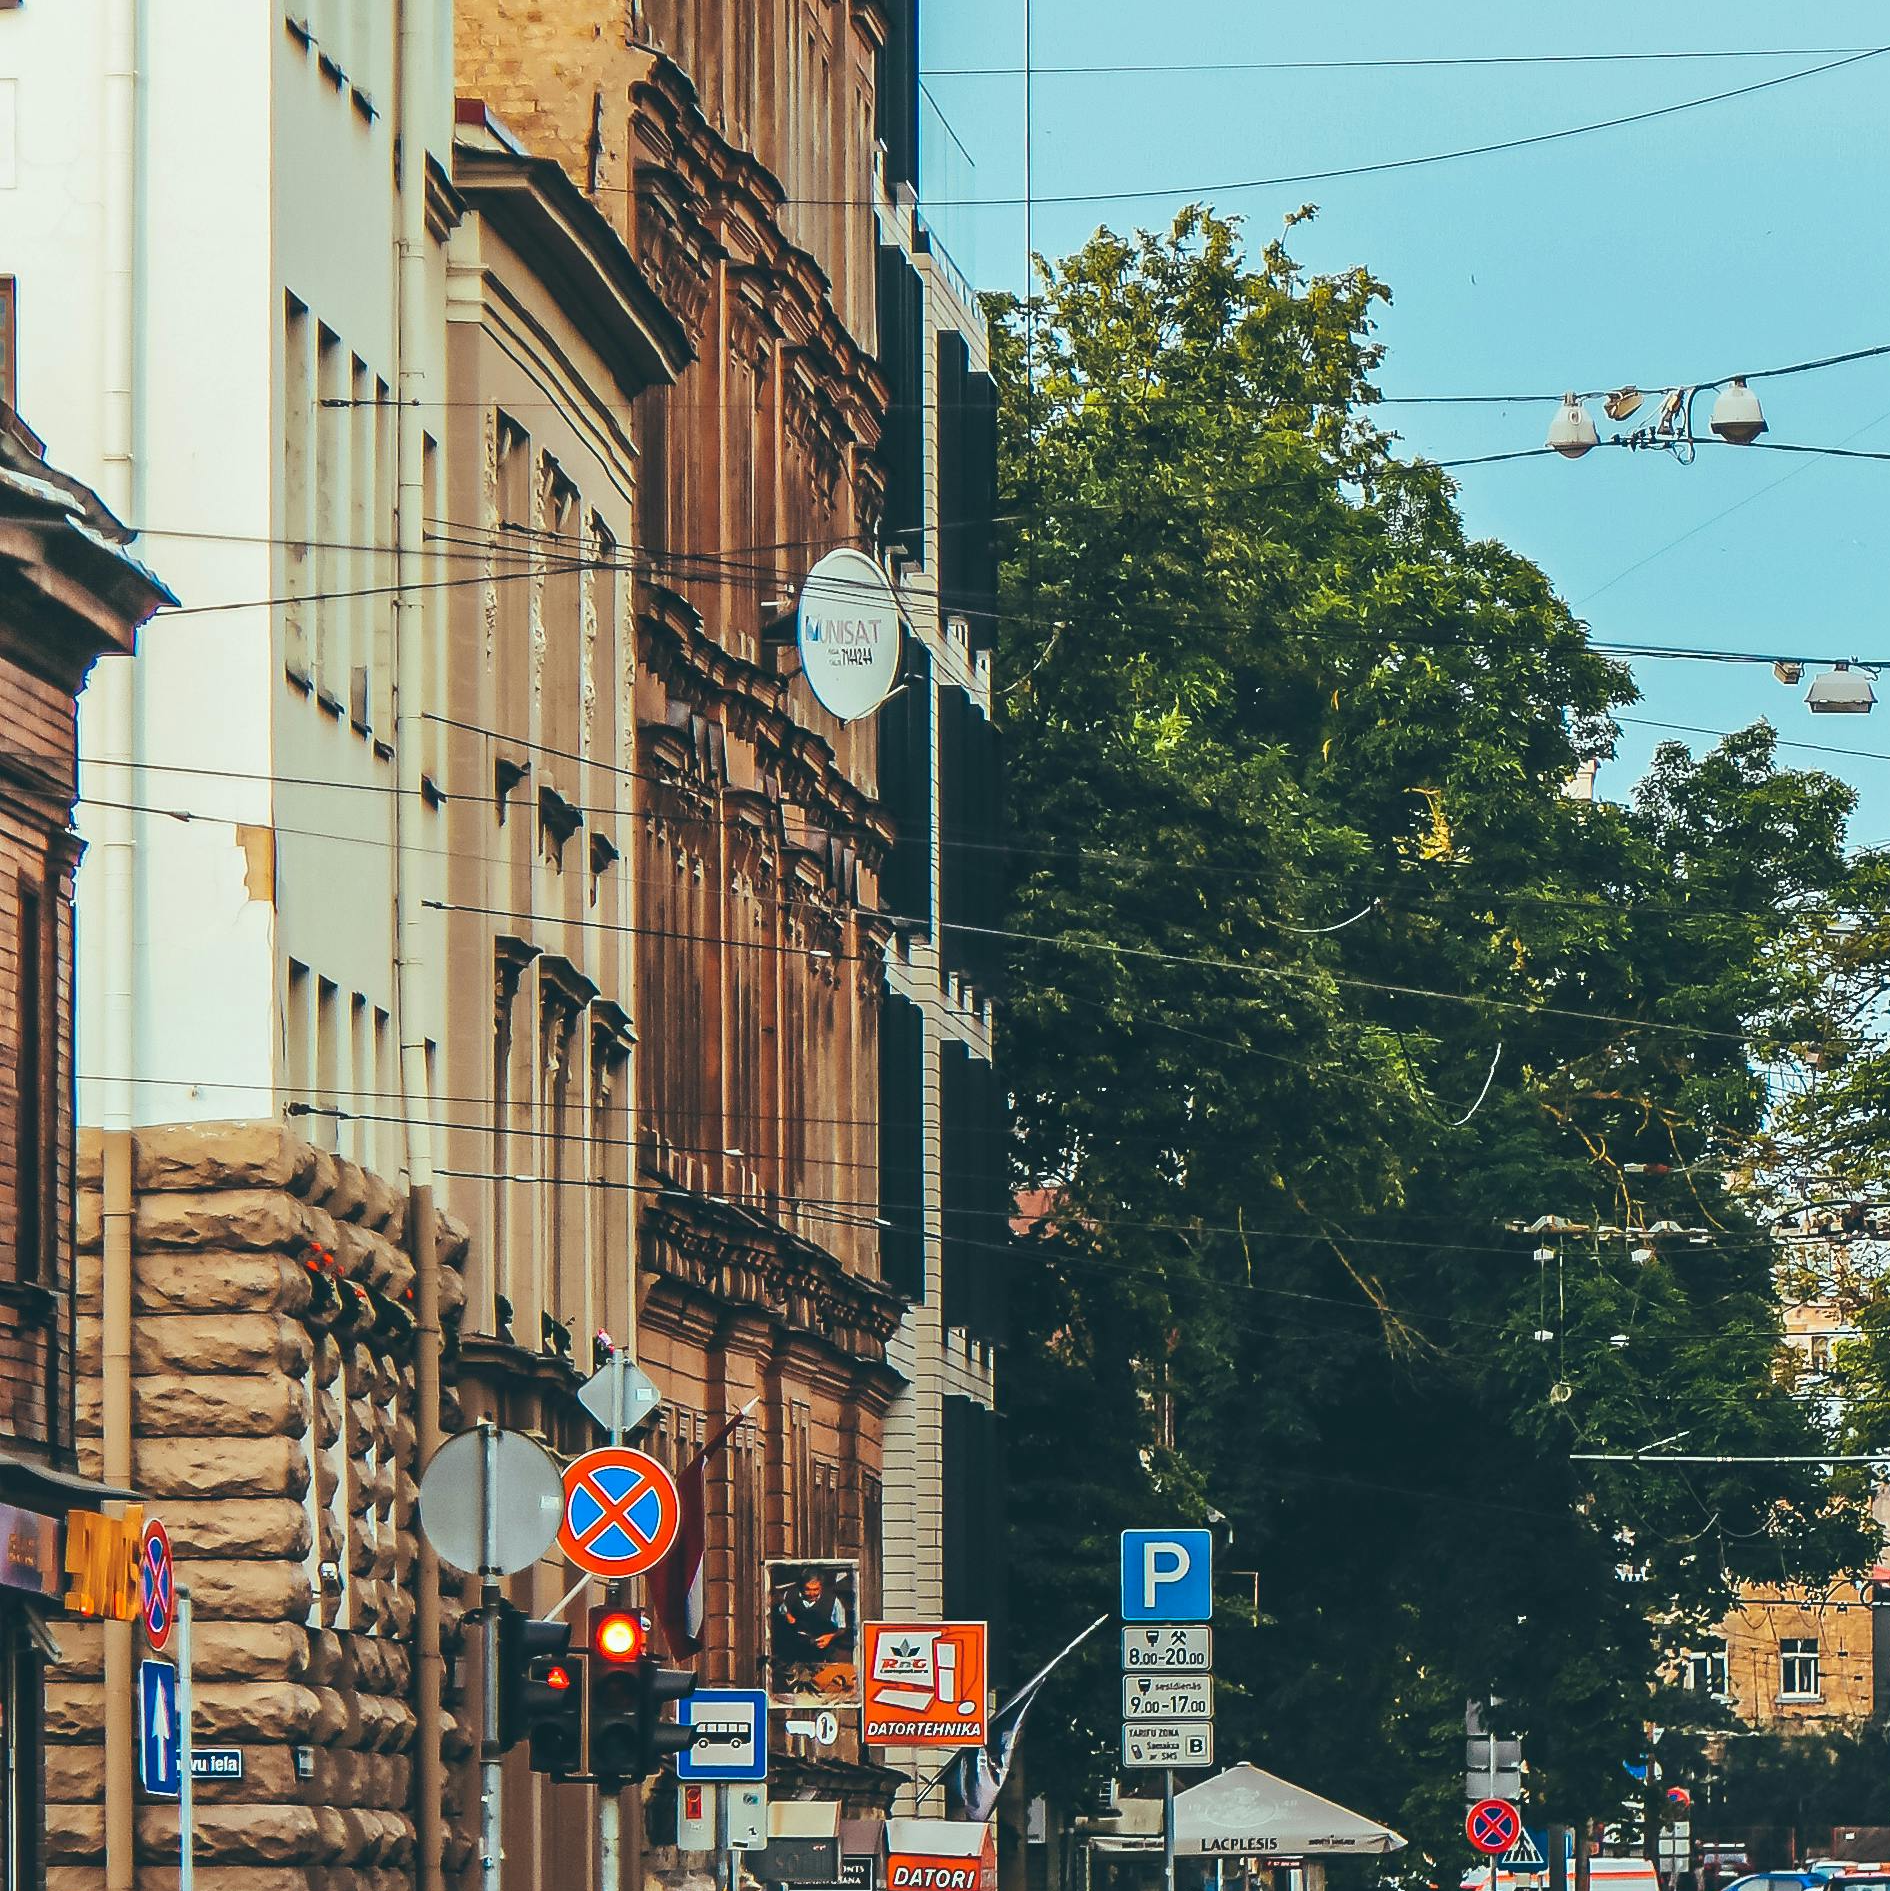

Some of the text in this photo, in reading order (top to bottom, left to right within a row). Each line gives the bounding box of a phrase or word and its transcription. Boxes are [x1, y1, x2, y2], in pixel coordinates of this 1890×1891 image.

[1143, 1542, 1191, 1608] P
[1129, 1647, 1205, 1666] 8.00-20.00
[1130, 1695, 1206, 1714] 9.00-17.00
[867, 1722, 981, 1736] DATORTEHNIKA
[1158, 1728, 1179, 1738] ZONA
[1189, 1738, 1203, 1753] B
[210, 1755, 238, 1772] iela
[894, 1867, 975, 1890] DATORI
